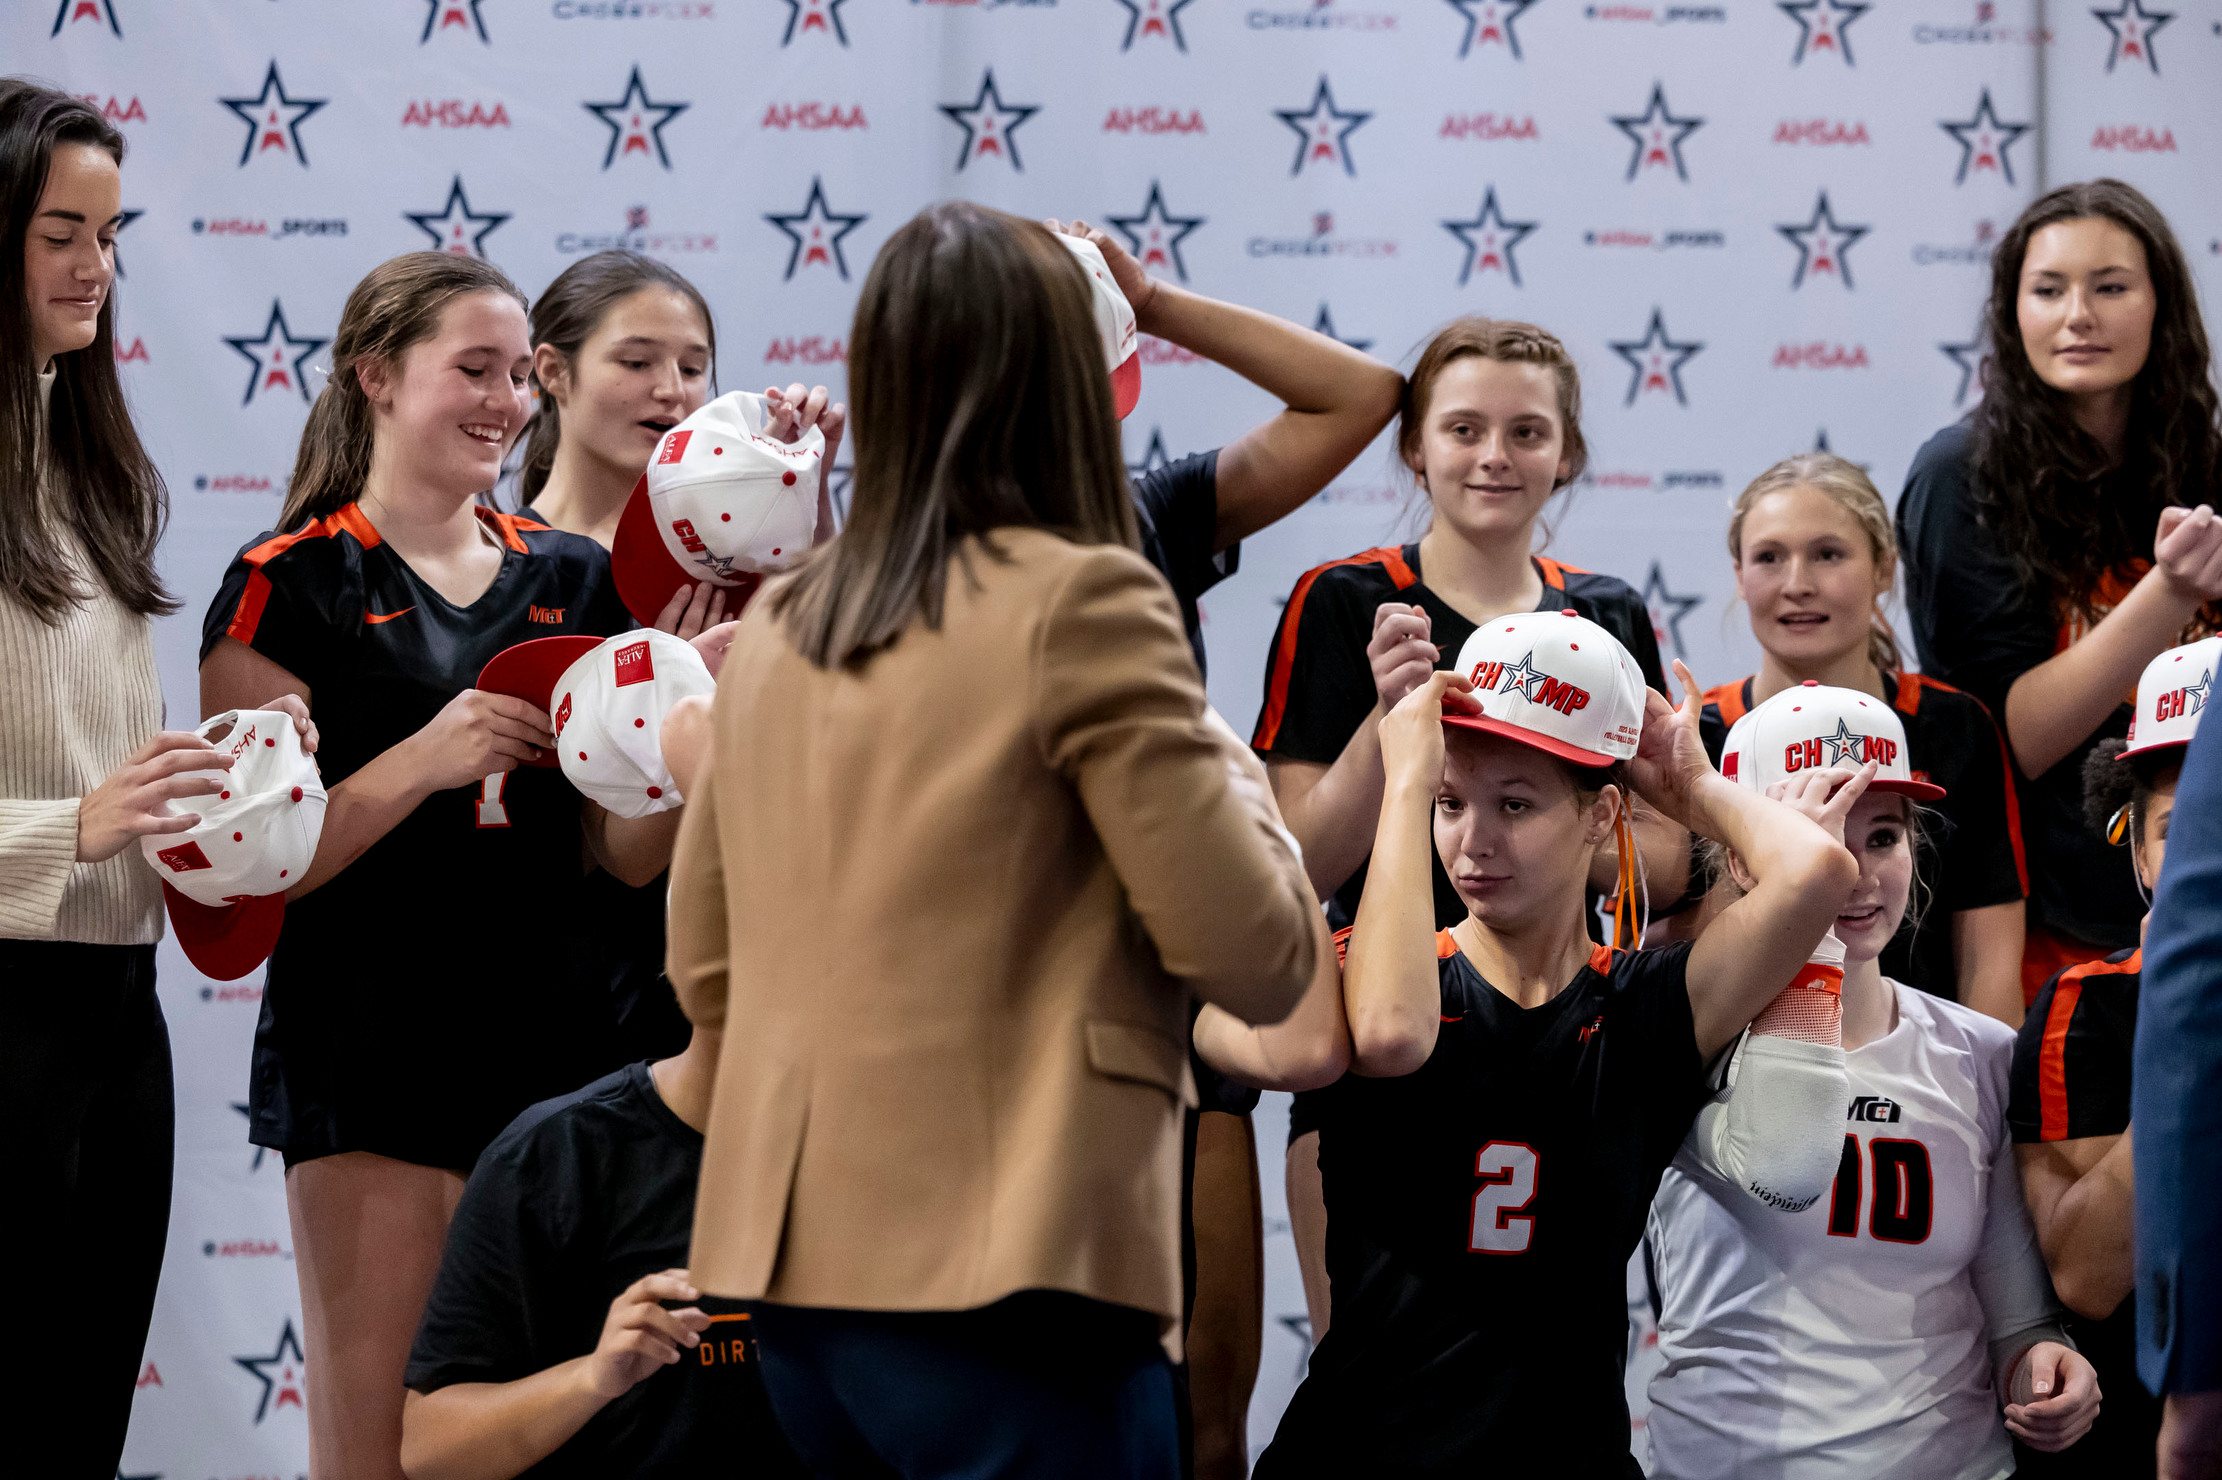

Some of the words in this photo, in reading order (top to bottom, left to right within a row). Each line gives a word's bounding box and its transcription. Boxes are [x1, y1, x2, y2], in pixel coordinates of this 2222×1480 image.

[402, 101, 511, 128] AHSAA
[763, 103, 868, 131] AHSAA
[1104, 107, 1206, 134] AHSAA
[1440, 112, 1540, 140] AHSAA
[1774, 119, 1871, 146] AHSAA
[2090, 125, 2177, 153] AHSAA
[764, 337, 848, 366] AHSA
[1773, 344, 1869, 370] AHSAA
[617, 648, 645, 668] ALFA
[1785, 716, 1897, 773] CHAMP
[1467, 1140, 1540, 1256] 2
[1827, 1132, 1934, 1245] 10
